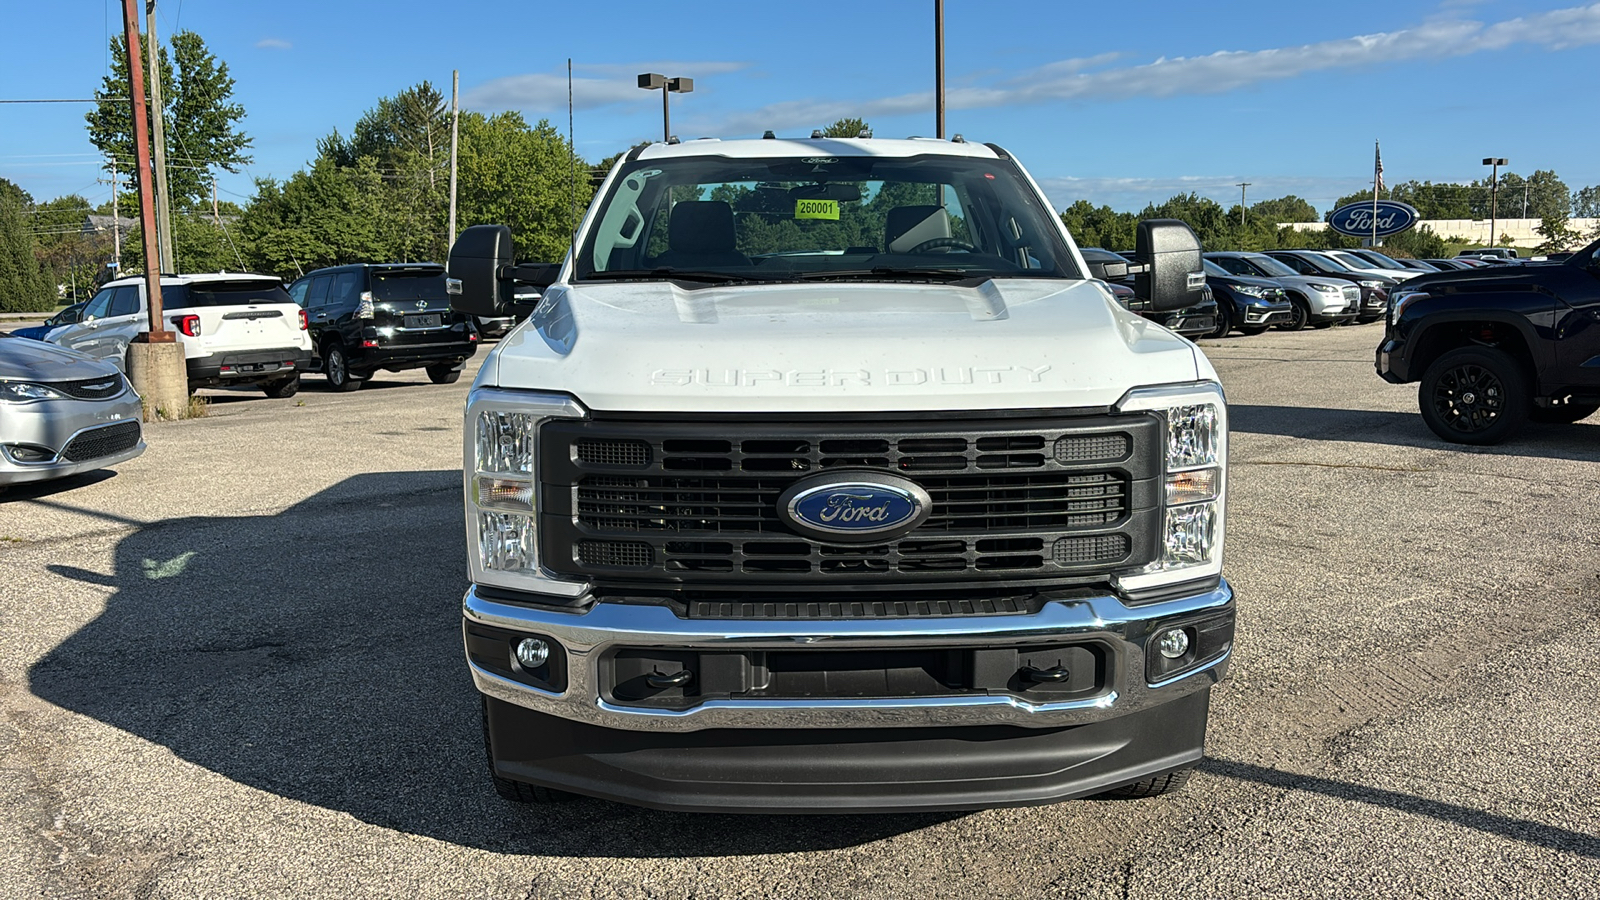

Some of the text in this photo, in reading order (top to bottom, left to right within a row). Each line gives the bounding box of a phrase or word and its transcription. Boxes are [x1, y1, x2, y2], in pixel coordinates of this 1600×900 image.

[800, 202, 833, 214] 260001
[1345, 208, 1397, 230] Ford
[650, 364, 1052, 387] SUPER DUTY
[819, 493, 890, 522] Ford
